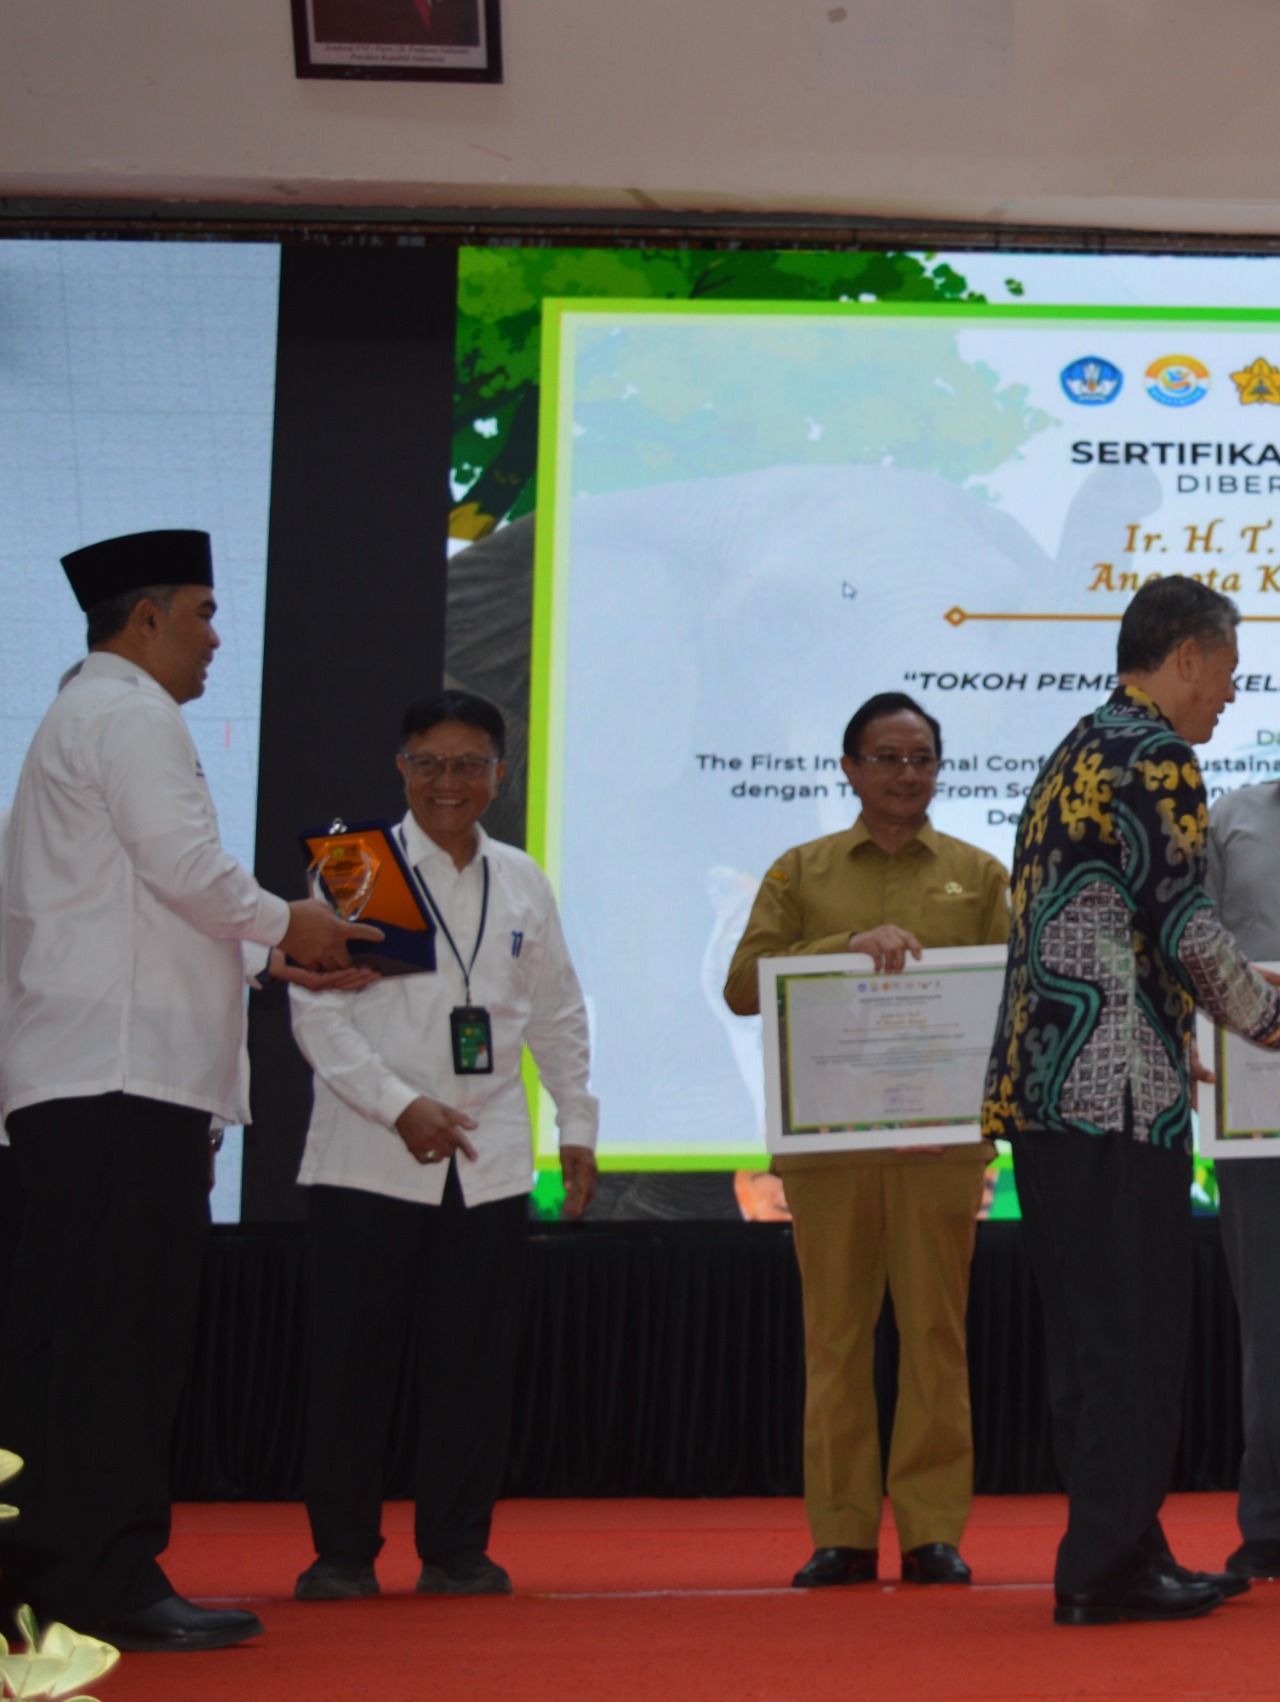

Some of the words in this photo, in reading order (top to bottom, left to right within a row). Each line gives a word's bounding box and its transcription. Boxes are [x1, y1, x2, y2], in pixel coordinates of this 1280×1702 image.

[1123, 524, 1168, 553] Ir.
[1183, 518, 1224, 553] H.
[1240, 518, 1275, 554] T.
[1088, 562, 1242, 592] Anta
[696, 754, 743, 771] The
[751, 753, 806, 771] First
[731, 779, 829, 801] dengan
